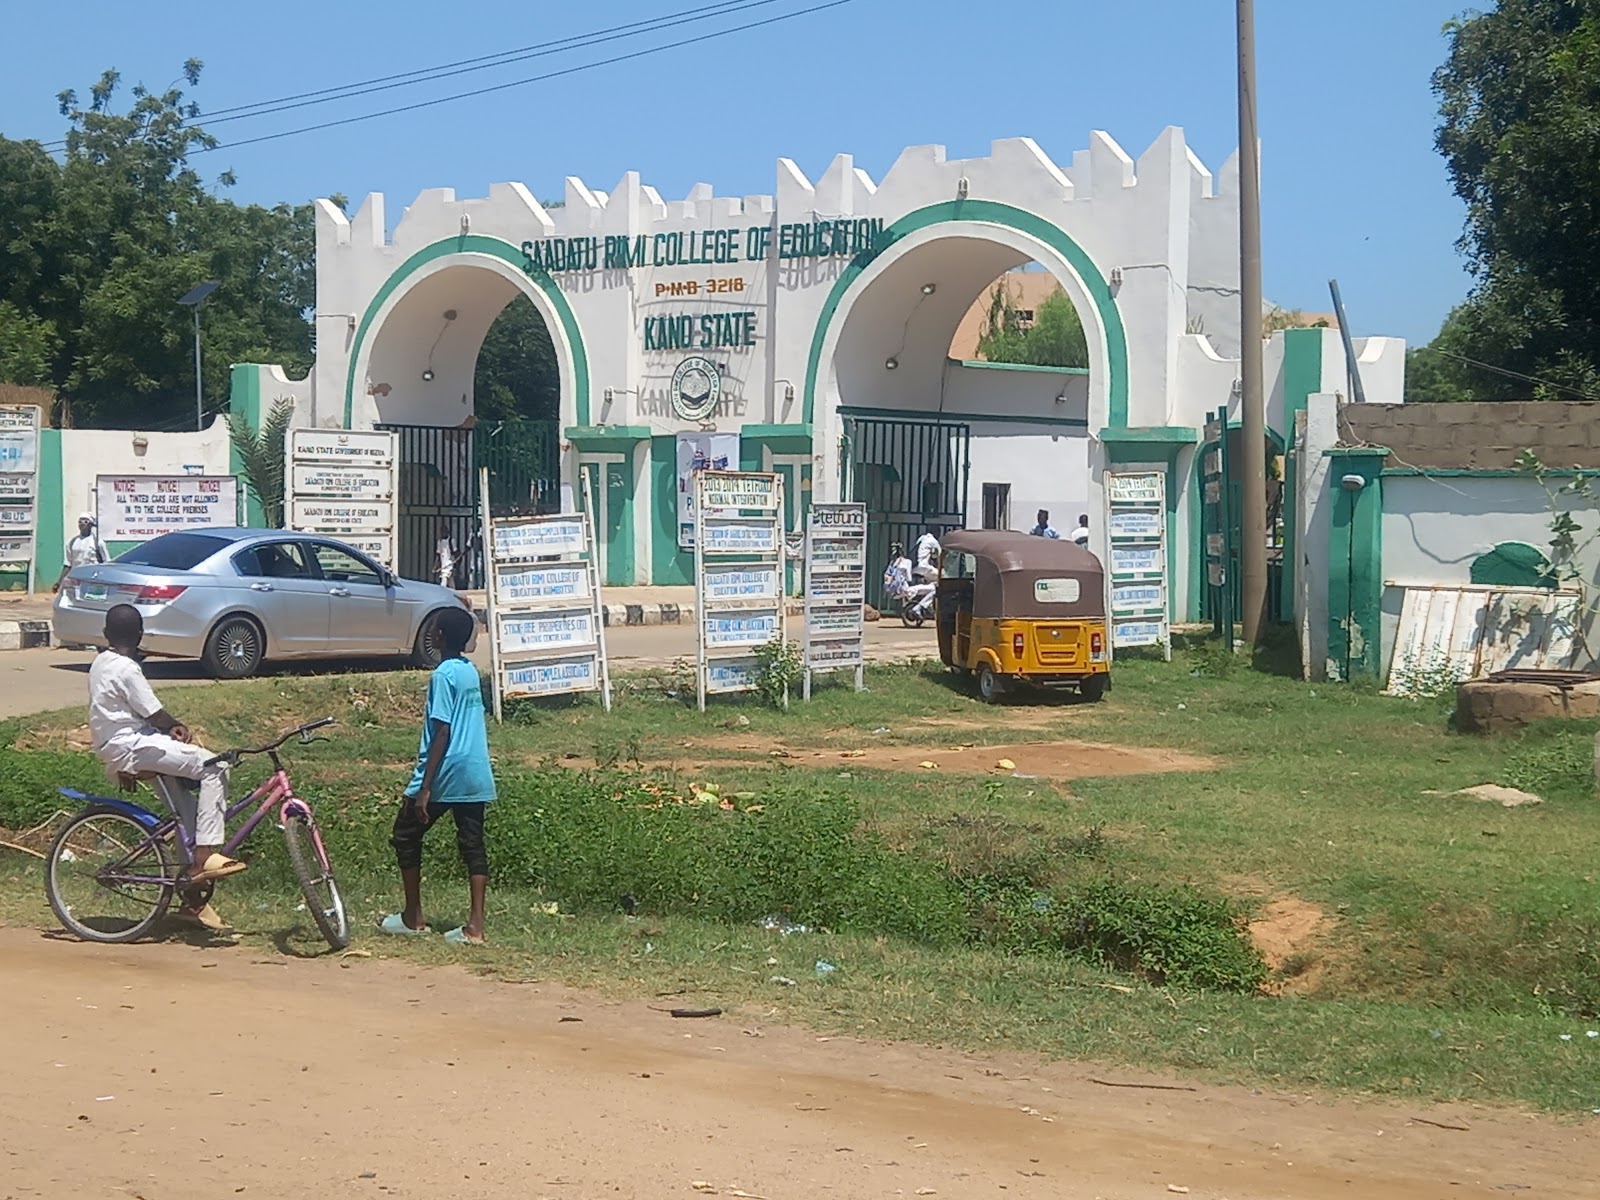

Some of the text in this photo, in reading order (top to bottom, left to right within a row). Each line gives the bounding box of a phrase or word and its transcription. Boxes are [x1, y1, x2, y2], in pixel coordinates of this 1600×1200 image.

[604, 234, 648, 270] RIMI
[653, 229, 740, 267] COLLEGE
[746, 226, 773, 262] OF
[778, 217, 884, 259] EDUCATION
[705, 278, 744, 293] 3218
[644, 312, 756, 351] KANO STATE
[298, 446, 314, 454] KANO
[316, 446, 333, 455] STATE
[116, 494, 219, 504] ALL TINTED CARS ARE NOT ALLOWED
[125, 506, 131, 514] IN
[134, 506, 142, 514] TO
[144, 506, 155, 514] THE
[156, 505, 180, 514] COLLEGE
[546, 572, 572, 584] COLLEGE
